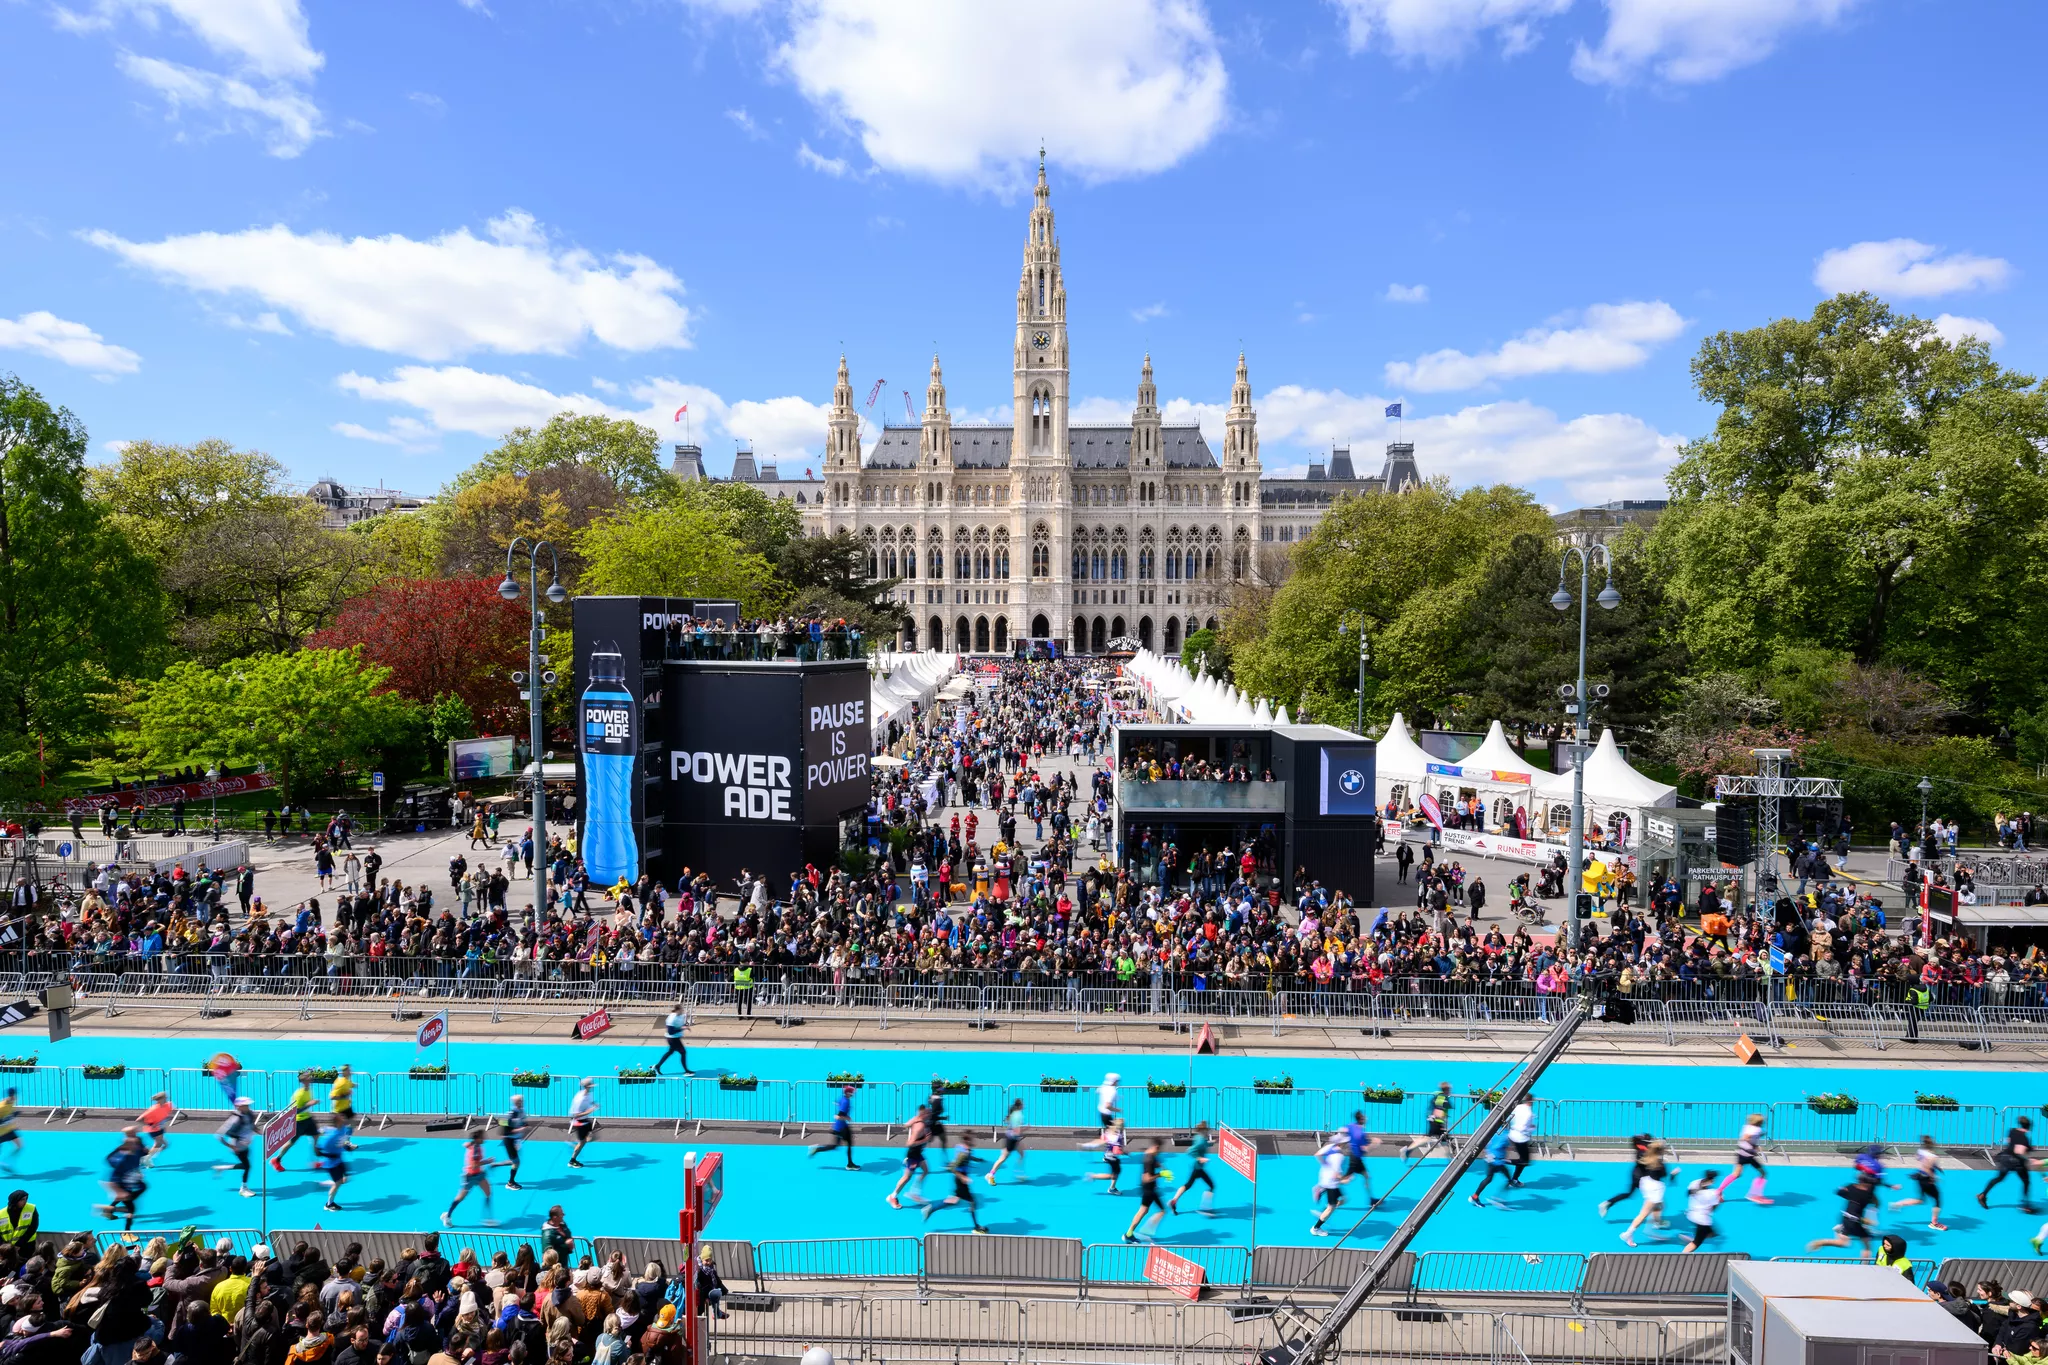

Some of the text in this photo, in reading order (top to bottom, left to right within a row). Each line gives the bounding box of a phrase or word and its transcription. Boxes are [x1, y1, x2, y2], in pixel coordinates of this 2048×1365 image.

[586, 709, 629, 723] POWER
[810, 700, 864, 732] PAUSE
[605, 723, 629, 737] ADE
[831, 730, 846, 756] IS
[671, 750, 791, 788] POWER
[808, 753, 867, 790] POWER
[724, 786, 791, 821] ADE
[1444, 832, 1472, 840] AUSTRIA
[1444, 837, 1465, 845] TREND
[1497, 844, 1537, 857] RUNNERS
[1153, 1264, 1193, 1285] STÄDTSCHE
